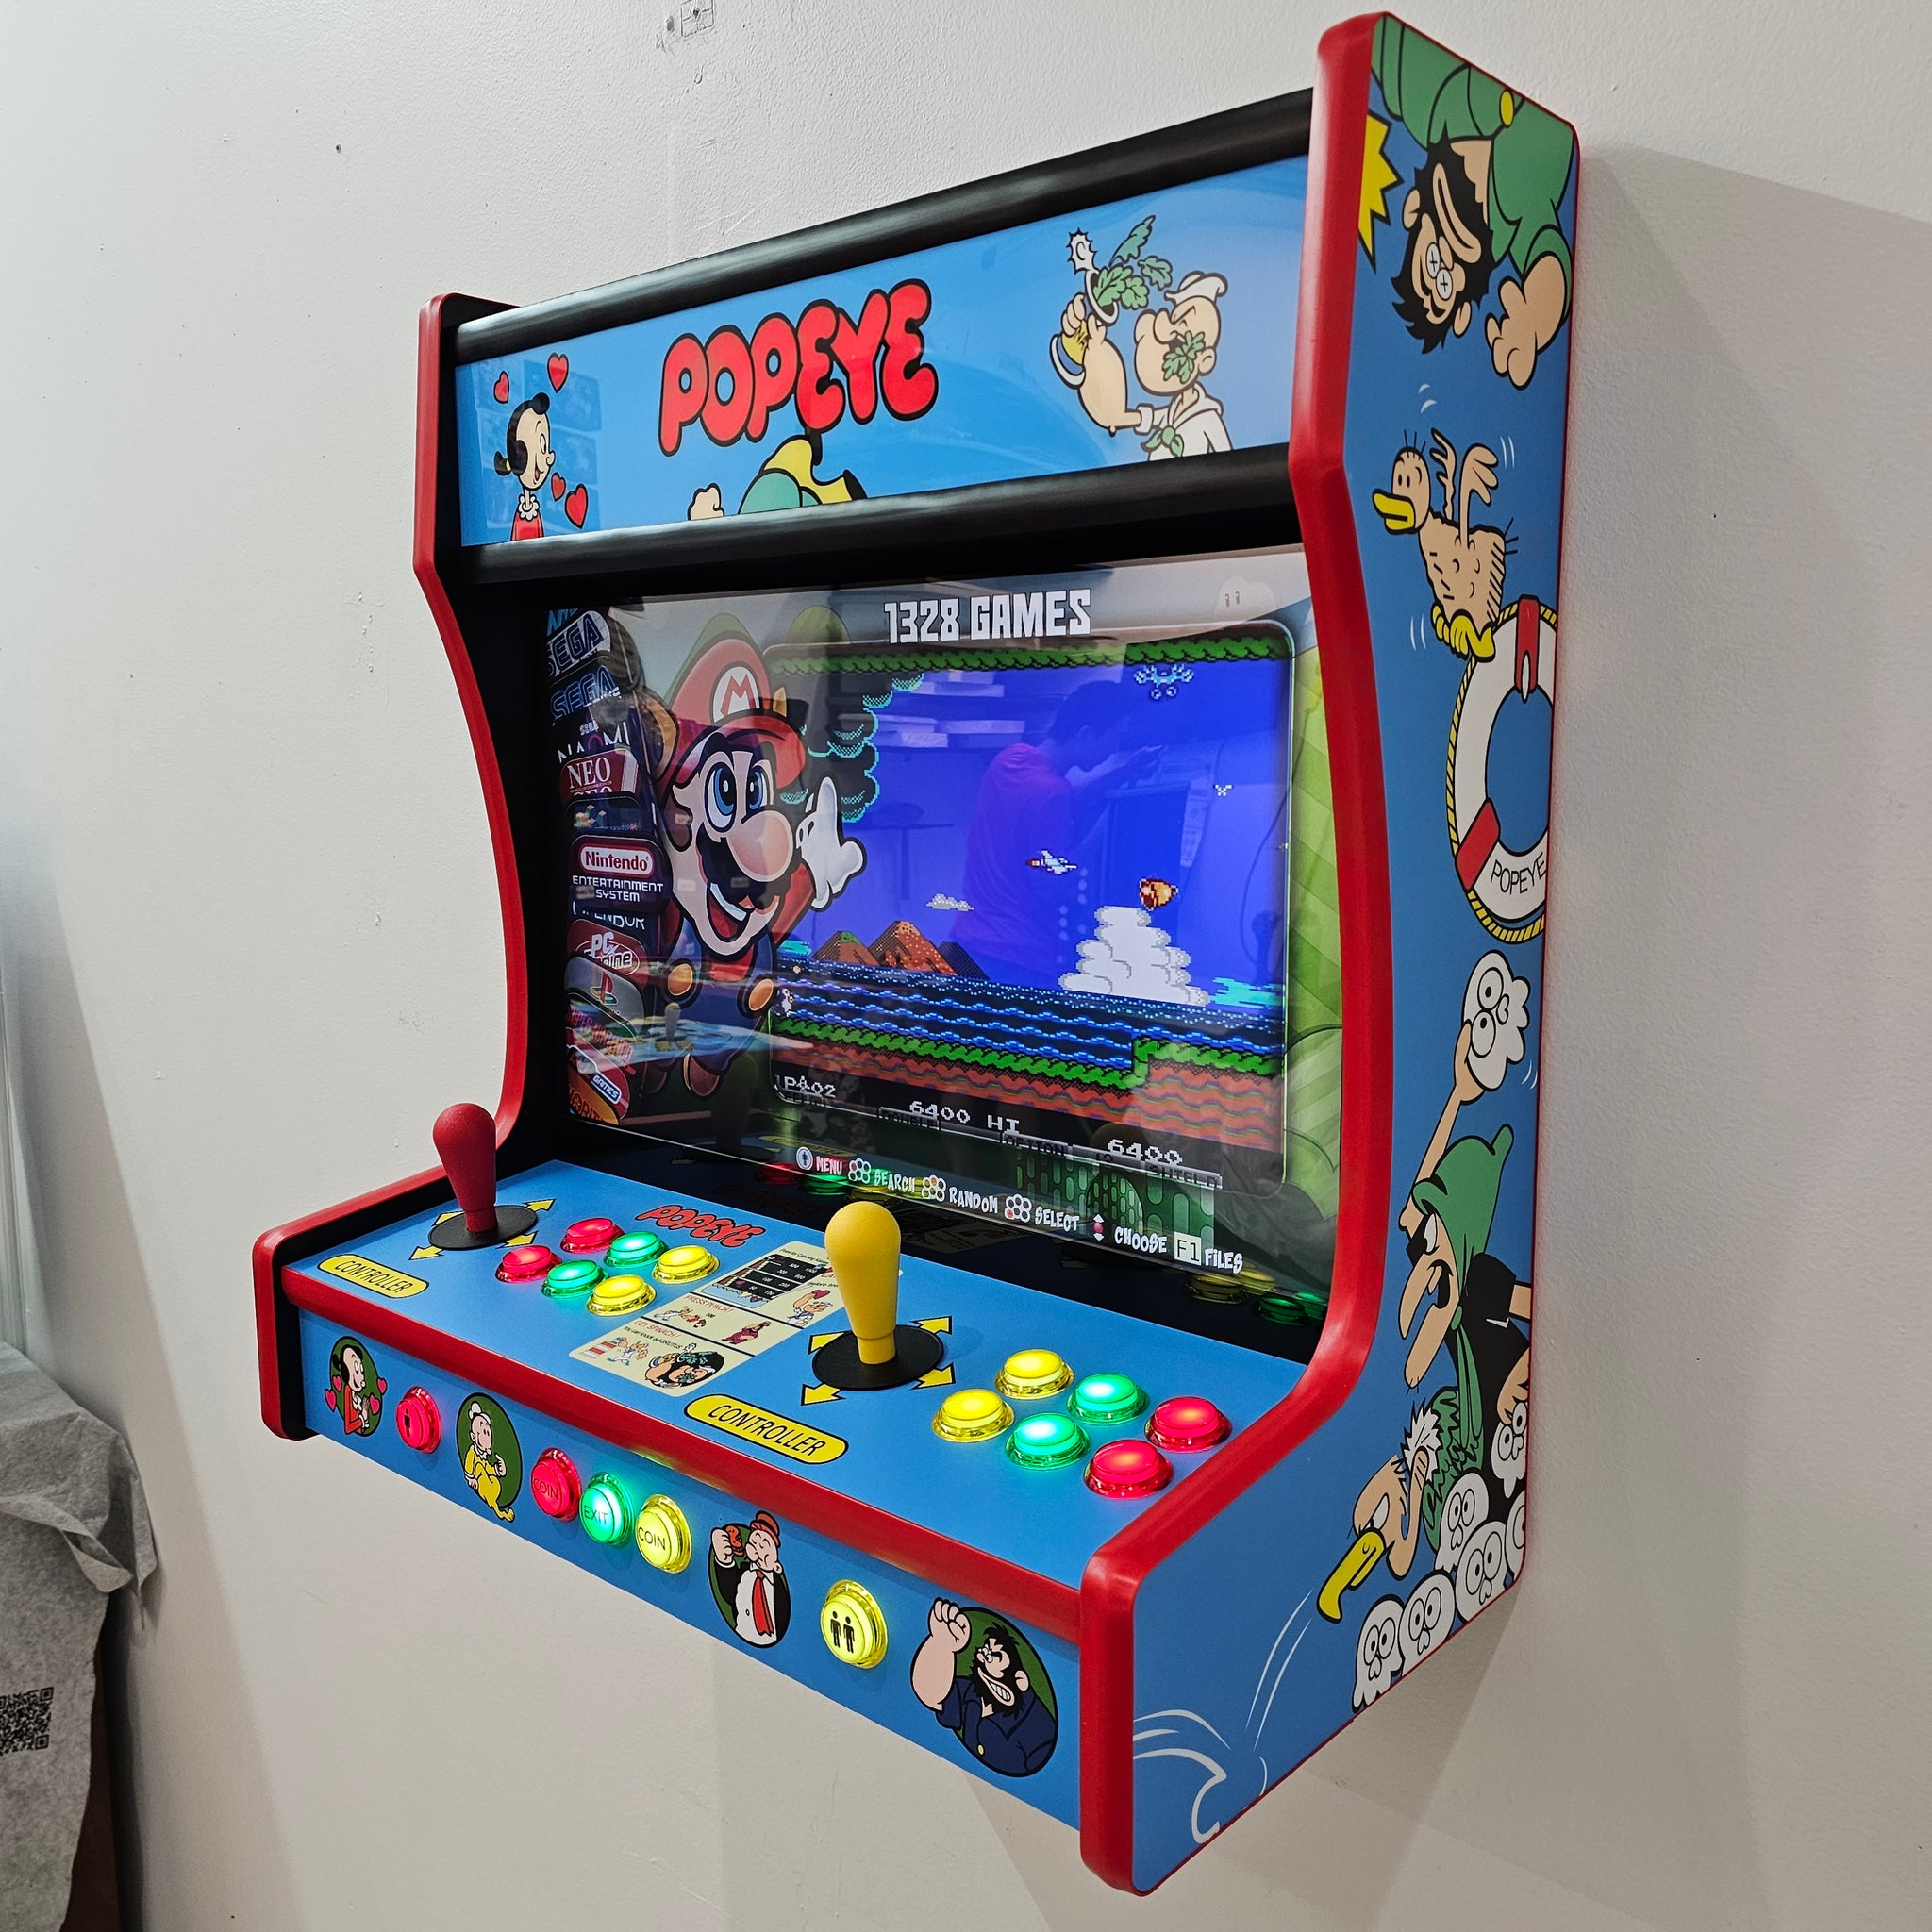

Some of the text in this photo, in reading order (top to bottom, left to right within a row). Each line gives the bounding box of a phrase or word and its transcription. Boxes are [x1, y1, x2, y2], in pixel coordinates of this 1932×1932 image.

[658, 278, 938, 457] POPEYE
[884, 588, 1091, 644] 1328 GAMES
[567, 757, 611, 789] NEO
[585, 851, 649, 872] Nintendo
[1491, 852, 1545, 895] POPEYE
[572, 875, 664, 893] ENTERTAINMENT
[595, 889, 641, 902] SYSTEM
[592, 1074, 619, 1099] GAMES
[909, 1100, 971, 1124] 6400
[1108, 1139, 1183, 1167] 6400
[815, 1155, 843, 1175] MENU
[874, 1168, 916, 1192] SEARCH
[948, 1186, 998, 1214] RANDOM
[635, 1204, 766, 1248] POPEYE
[1035, 1206, 1080, 1232] SELECT
[1114, 1226, 1168, 1254] CHOOSE
[1177, 1240, 1200, 1263] F1
[334, 1260, 414, 1294] CONTROLLER
[708, 1403, 827, 1458] CONTROLLER
[532, 1477, 558, 1501] COIN
[584, 1505, 608, 1525] EXIT
[637, 1526, 667, 1551] COIN
